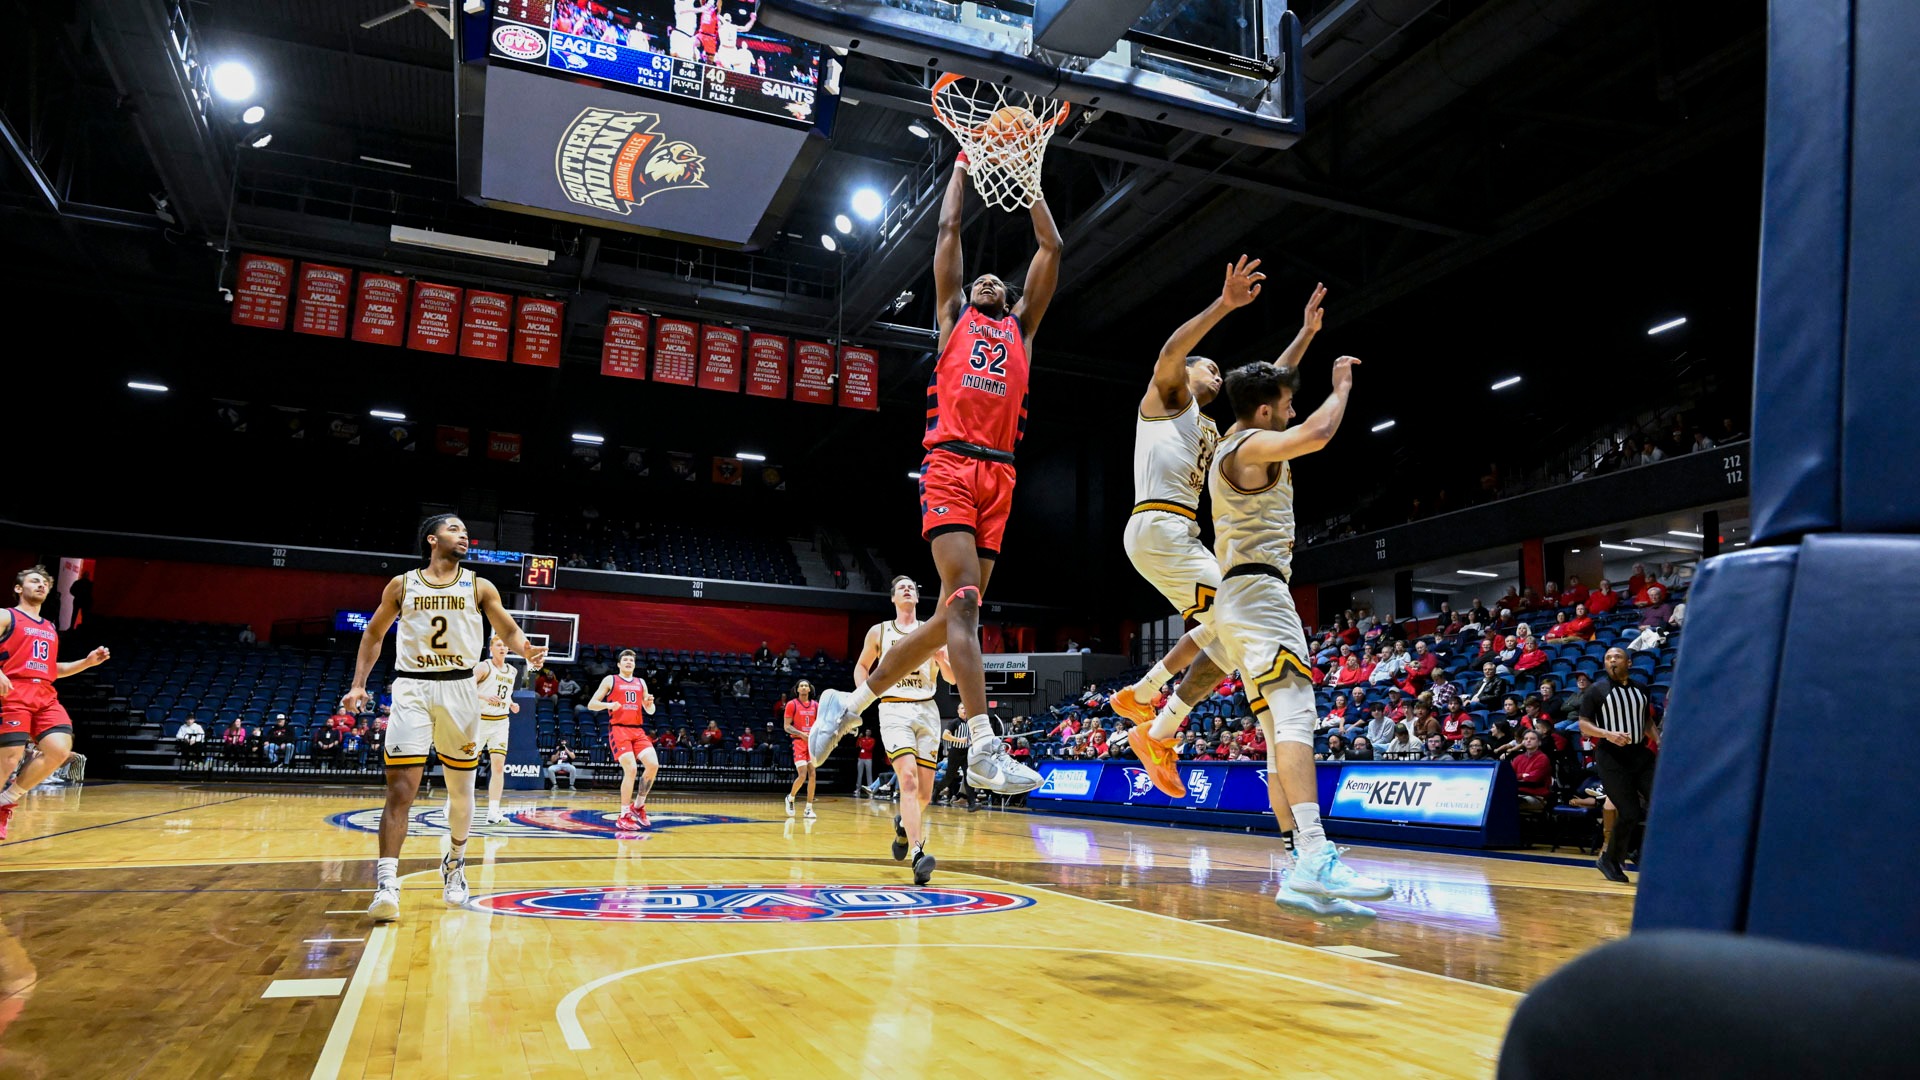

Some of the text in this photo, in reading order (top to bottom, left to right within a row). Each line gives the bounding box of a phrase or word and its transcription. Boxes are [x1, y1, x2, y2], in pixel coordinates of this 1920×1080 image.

[551, 34, 617, 61] EAGLES
[652, 56, 671, 72] 63
[638, 67, 657, 78] TOL:
[706, 68, 726, 84] 40
[710, 82, 729, 94] TOL:
[762, 82, 815, 105] SAINTS
[562, 110, 615, 205] SOUTHERN
[584, 116, 647, 211] INDIANA
[617, 136, 646, 198] SCREAMING EAGLES
[310, 293, 336, 302] NCAA
[368, 304, 392, 313] NCAA
[472, 308, 502, 316] VOLLEYBALL
[422, 312, 448, 321] NCAA
[524, 315, 554, 323] VOLLEYBALL
[527, 322, 550, 332] NCAA
[968, 320, 1014, 344] SOUTHERN
[666, 344, 686, 352] NCAA
[710, 354, 731, 362] NCAA
[757, 360, 778, 368] NCAA
[969, 339, 1008, 377] 52
[804, 366, 824, 375] NCAA
[849, 372, 868, 380] NCAA
[961, 374, 1006, 396] INDIANA
[1724, 455, 1741, 470] 212
[1726, 470, 1742, 484] 112
[1376, 538, 1386, 548] 213
[273, 548, 286, 556] 202
[1377, 550, 1386, 560] 113
[273, 558, 286, 567] 102
[532, 558, 554, 568] 6:49
[528, 568, 549, 585] 27
[692, 590, 702, 598] 101
[414, 596, 465, 610] FIGHTING
[431, 616, 448, 649] 2
[32, 639, 48, 660] 13
[416, 654, 464, 668] SAINTS
[982, 661, 1026, 670] nterra Bank
[497, 684, 508, 700] 13
[625, 690, 636, 704] 10
[504, 764, 540, 774] OMAIN
[1346, 780, 1432, 806] Kenny KENT
